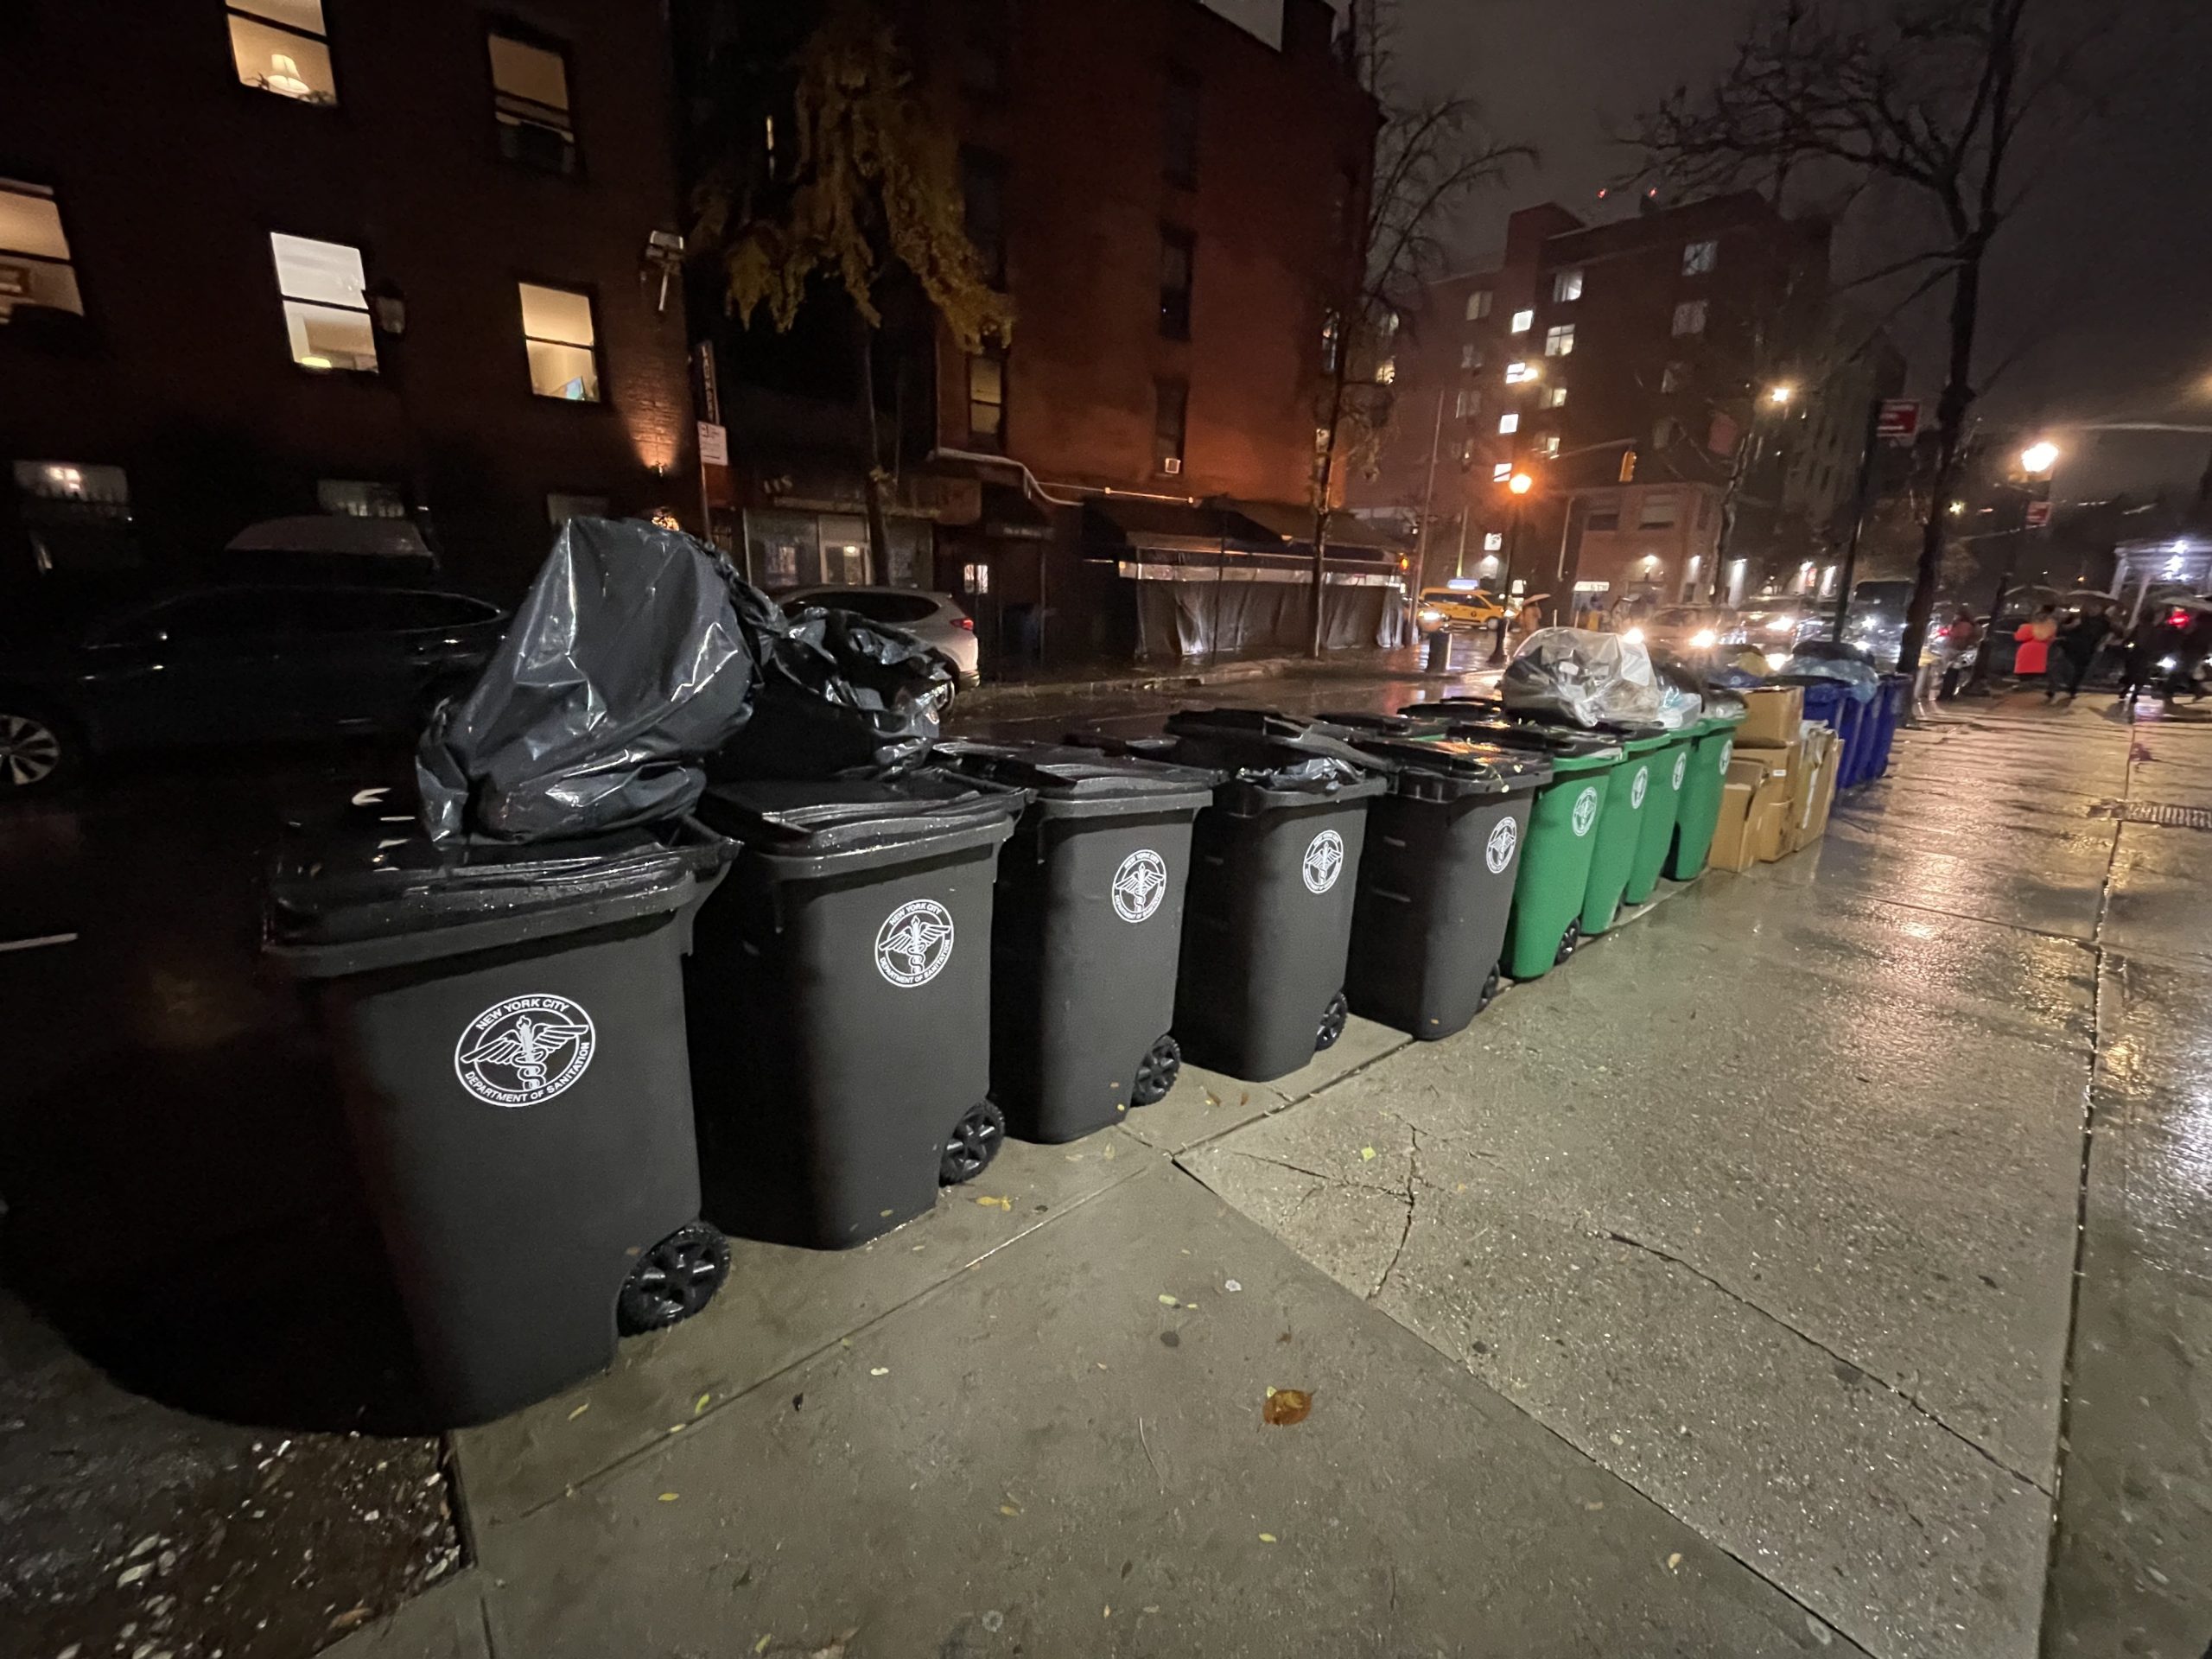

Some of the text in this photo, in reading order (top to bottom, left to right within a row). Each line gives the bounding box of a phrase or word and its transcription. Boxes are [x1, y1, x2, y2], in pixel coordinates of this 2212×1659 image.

[906, 903, 926, 913] YORK
[927, 903, 943, 915] CITY
[924, 939, 950, 976] SANITATION
[475, 999, 569, 1030] NEW YORK CITY
[465, 1041, 590, 1103] DEPARTMENT OF SANITATION
